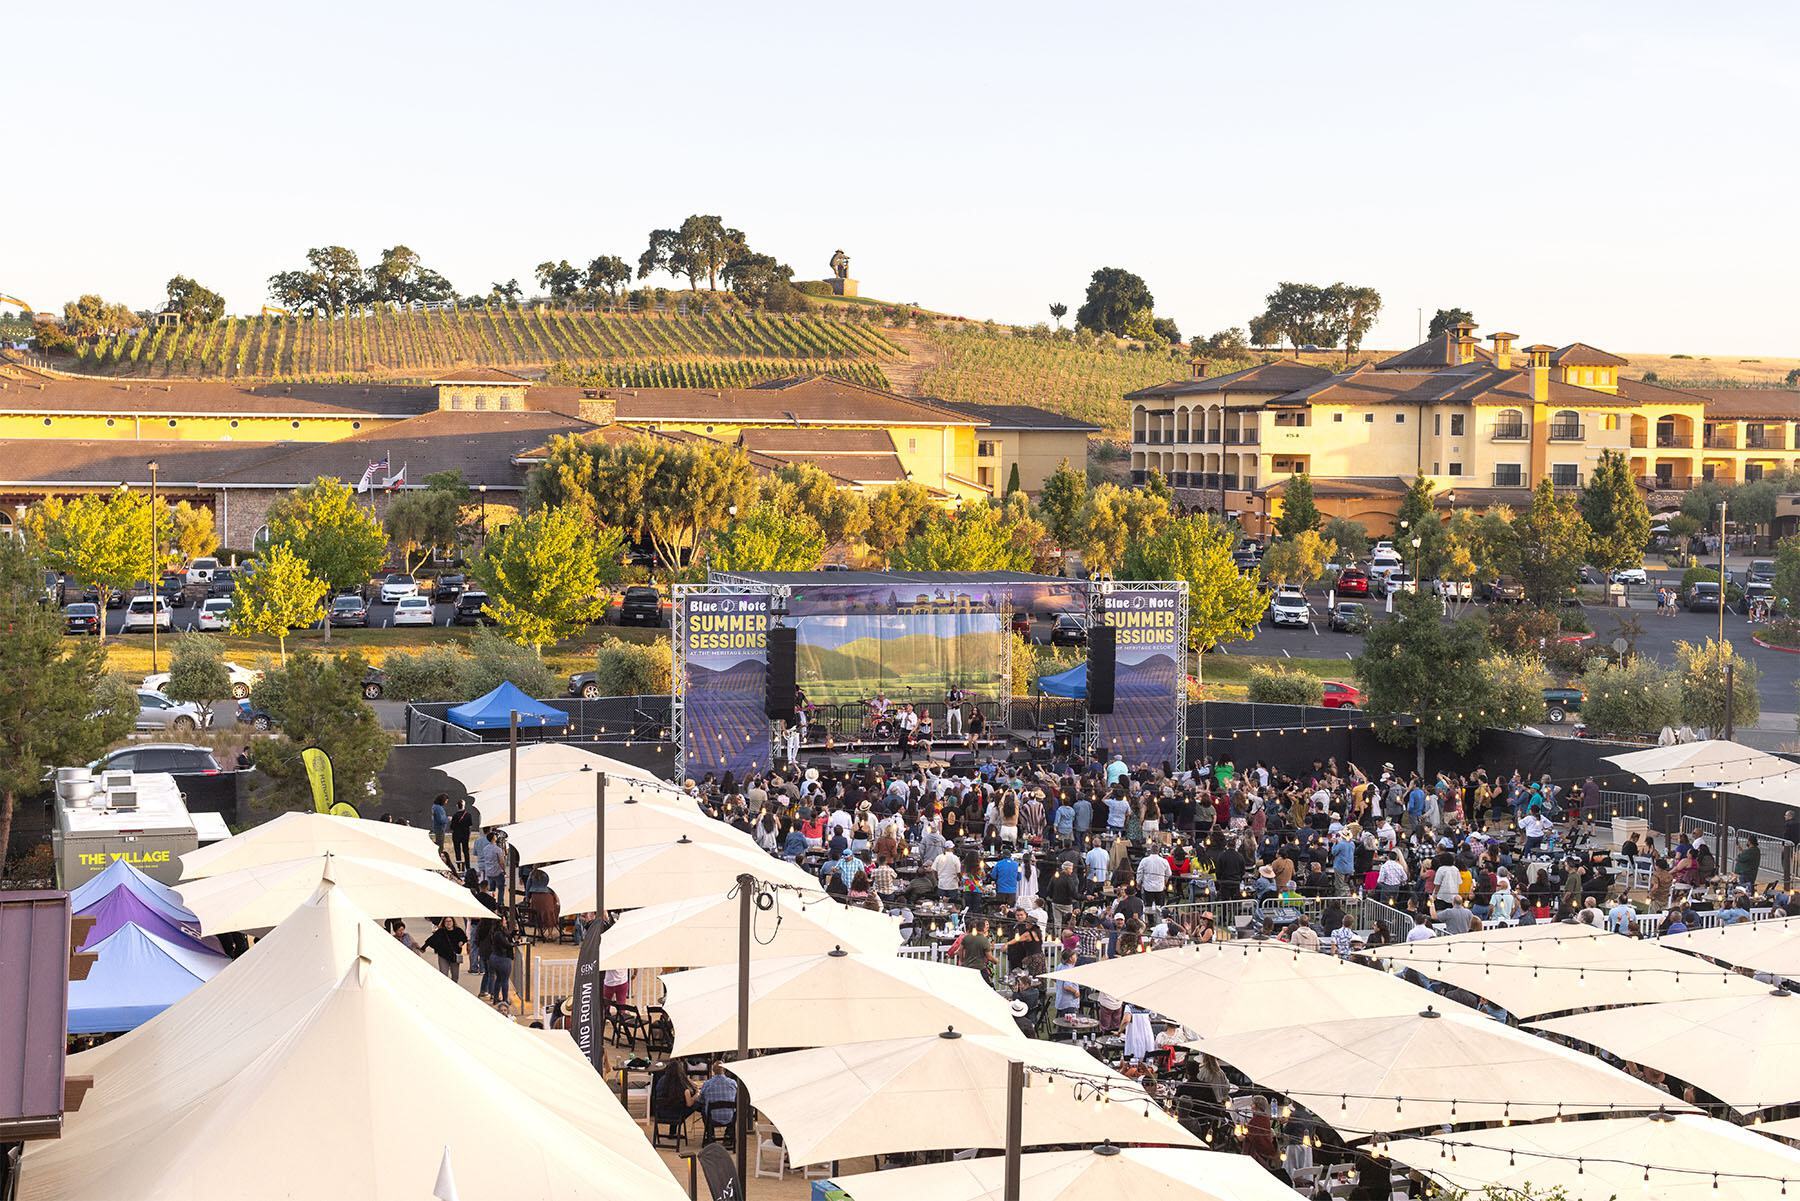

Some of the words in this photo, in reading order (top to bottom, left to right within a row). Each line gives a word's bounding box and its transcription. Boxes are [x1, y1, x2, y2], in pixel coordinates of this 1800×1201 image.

[690, 601, 718, 612] Blue
[739, 601, 767, 612] Note
[1105, 598, 1130, 609] Blue
[1149, 598, 1174, 609] Note
[689, 614, 767, 632] SUMMER
[1104, 611, 1175, 628] SUMMER
[689, 633, 767, 649] SESSIONS
[1115, 629, 1175, 644] ESSIONS
[79, 854, 106, 865] THE
[110, 851, 170, 863] VILLAGE
[580, 982, 593, 1023] ROOM
